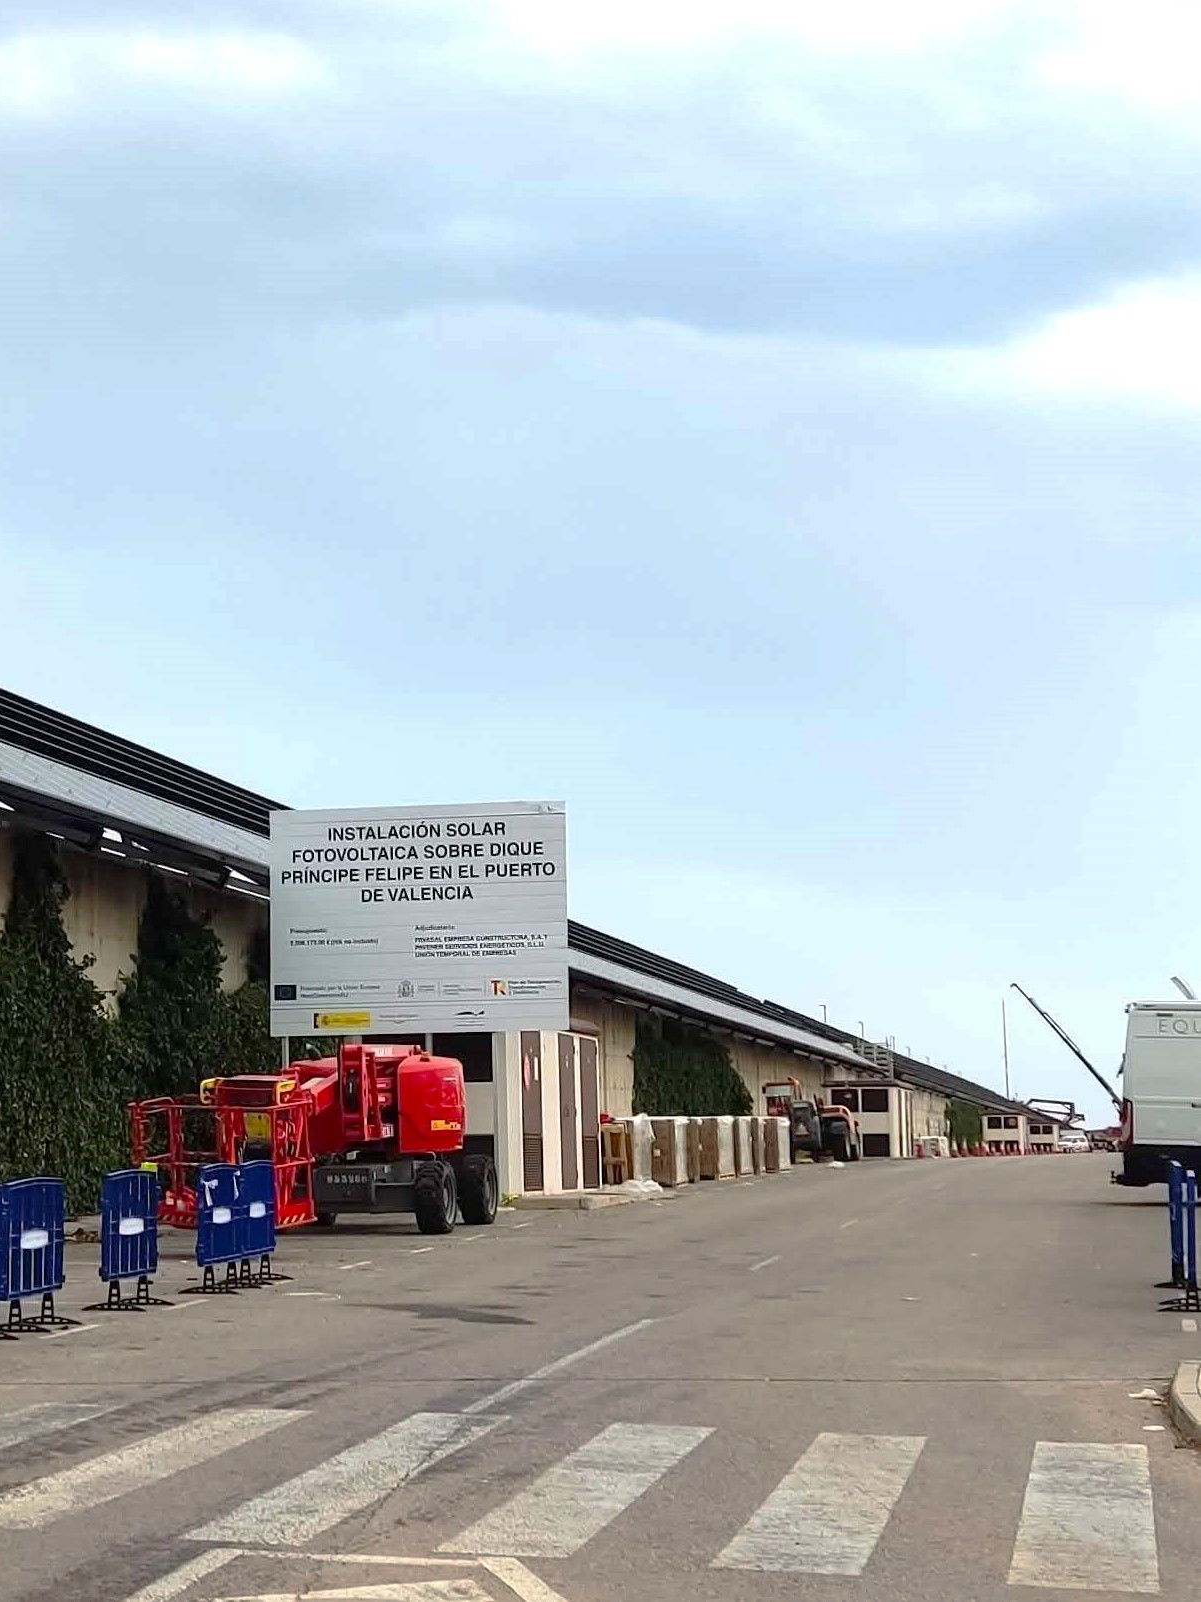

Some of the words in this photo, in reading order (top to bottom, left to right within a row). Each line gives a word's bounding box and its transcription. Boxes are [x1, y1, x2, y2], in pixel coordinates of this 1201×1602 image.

[328, 821, 441, 841] INSTALACIÓN
[446, 822, 506, 837] SOLAR
[292, 845, 419, 863] FOTOVOLTAICA
[424, 843, 484, 859] SOBRE
[490, 841, 544, 857] DIQUE
[281, 866, 360, 885] PRÍNCIPE
[365, 866, 424, 882] FELIPE
[429, 865, 452, 880] EN
[458, 864, 479, 879] EL
[485, 862, 555, 878] PUERTO
[361, 888, 384, 902] DE
[388, 885, 474, 902] VALENCIA
